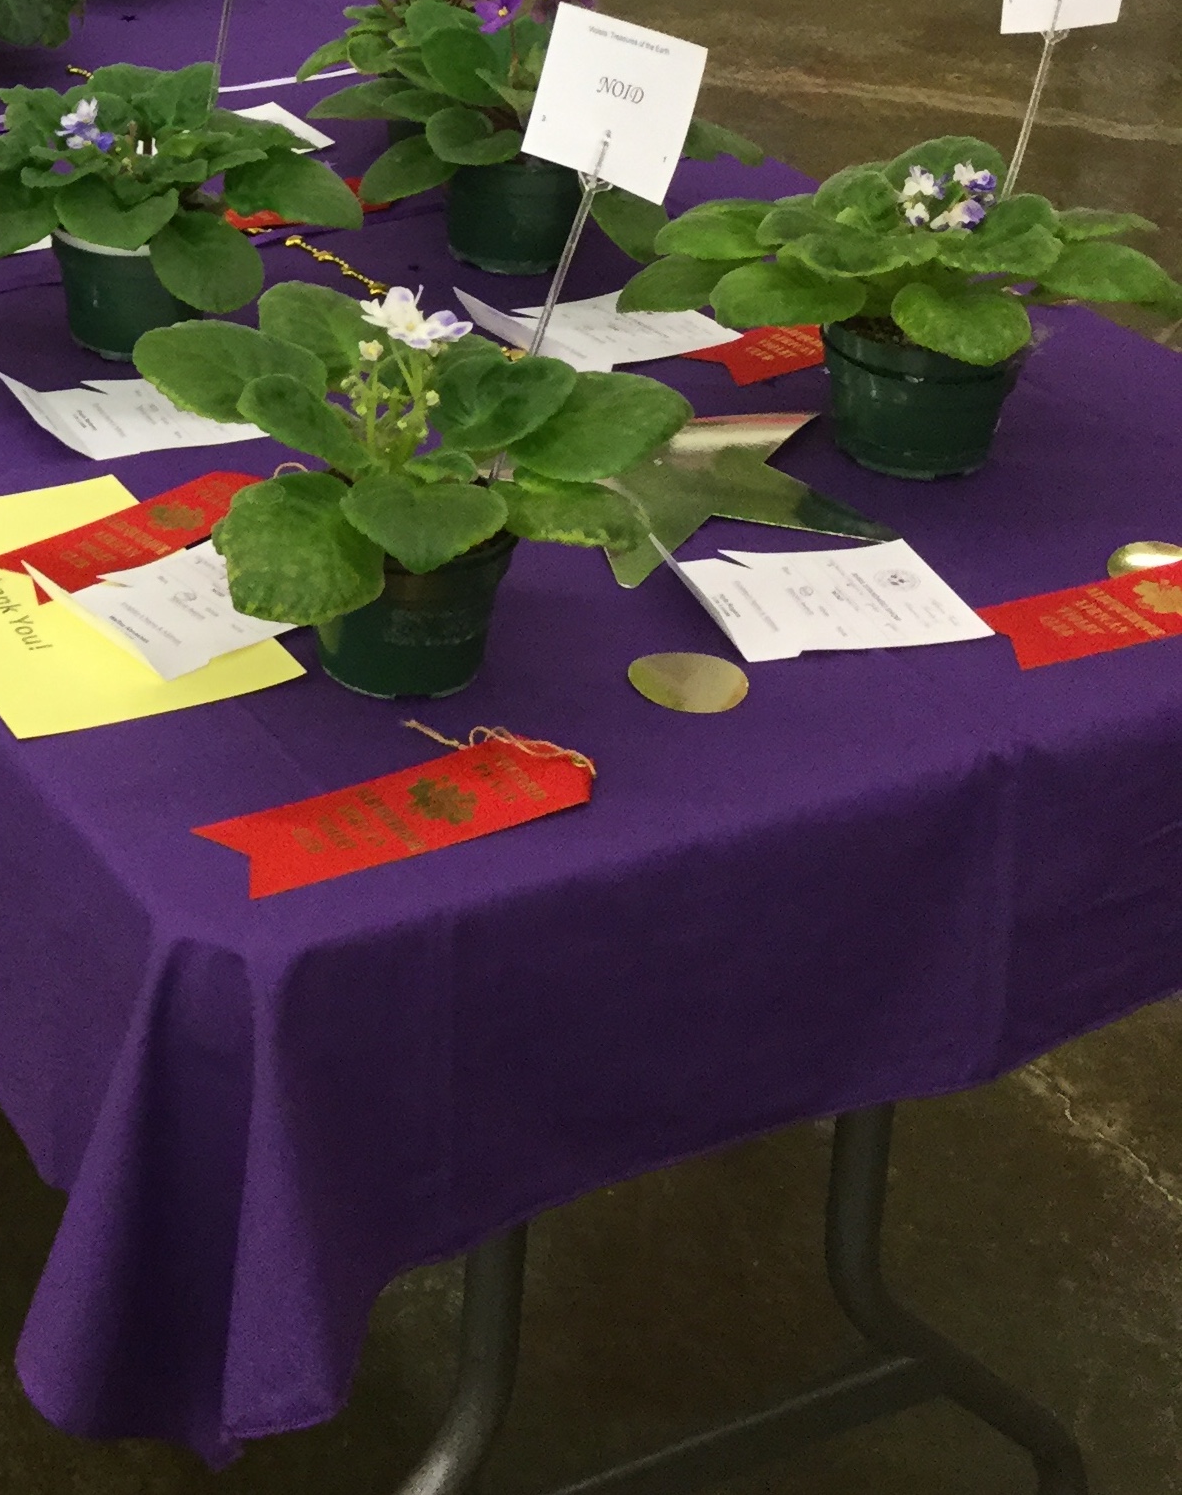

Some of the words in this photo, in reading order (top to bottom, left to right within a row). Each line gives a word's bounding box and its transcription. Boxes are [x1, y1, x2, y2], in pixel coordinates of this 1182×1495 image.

[645, 43, 655, 51] the
[655, 45, 670, 55] Earth
[596, 76, 645, 104] NOID
[8, 614, 54, 651] You!
